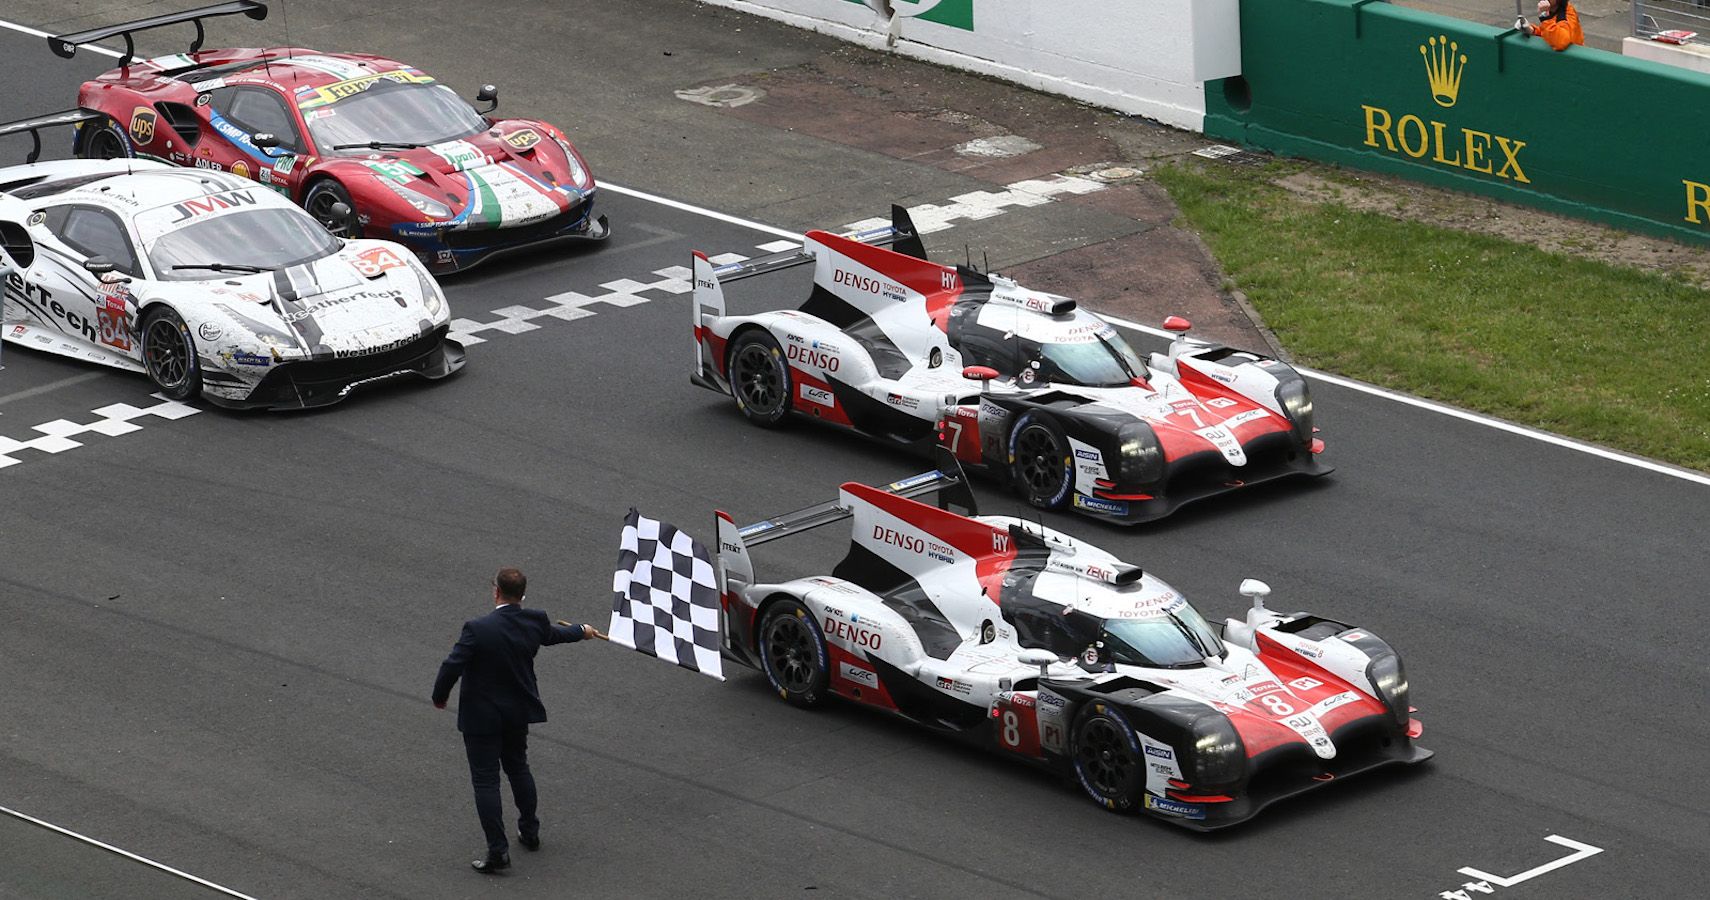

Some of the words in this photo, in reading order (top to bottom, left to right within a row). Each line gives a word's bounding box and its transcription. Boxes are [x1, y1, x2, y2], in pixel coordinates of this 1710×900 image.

[132, 117, 153, 138] ups
[509, 132, 538, 146] ups
[1361, 104, 1532, 184] ROLEX
[195, 157, 223, 171] ADLER
[171, 189, 257, 224] JMW
[354, 250, 401, 275] 84
[833, 268, 880, 294] DENSO
[882, 282, 907, 296] TOYOTA
[941, 271, 956, 290] HY
[882, 291, 907, 303] HYBRID
[1026, 297, 1049, 311] ZENT
[5, 271, 98, 344] erTech
[99, 310, 130, 347] 84
[1068, 321, 1105, 335] DENSO
[335, 333, 419, 359] WeatherTech
[1055, 334, 1095, 343] TOYOTA
[787, 343, 840, 373] DENSO
[1178, 408, 1207, 428] 7
[948, 421, 962, 453] 7
[1077, 451, 1098, 460] AISIN
[1087, 500, 1123, 512] MICHELIN
[722, 542, 741, 554] JTEKT
[873, 525, 924, 554] DENSO
[993, 532, 1009, 553] HY
[928, 542, 954, 556] TOYOTA
[928, 552, 955, 565] HYBRID
[1086, 564, 1113, 581] ZENT
[1134, 591, 1175, 609] DENSO
[1119, 608, 1162, 618] TOYOTA
[823, 617, 881, 650] DENSO
[1252, 683, 1279, 694] TOTAL
[1295, 678, 1318, 688] P1
[1261, 694, 1295, 716] 8
[1003, 710, 1020, 747] 8
[1045, 726, 1060, 744] P1
[1146, 747, 1171, 758] AISIN
[1159, 803, 1200, 815] MICHELIN
